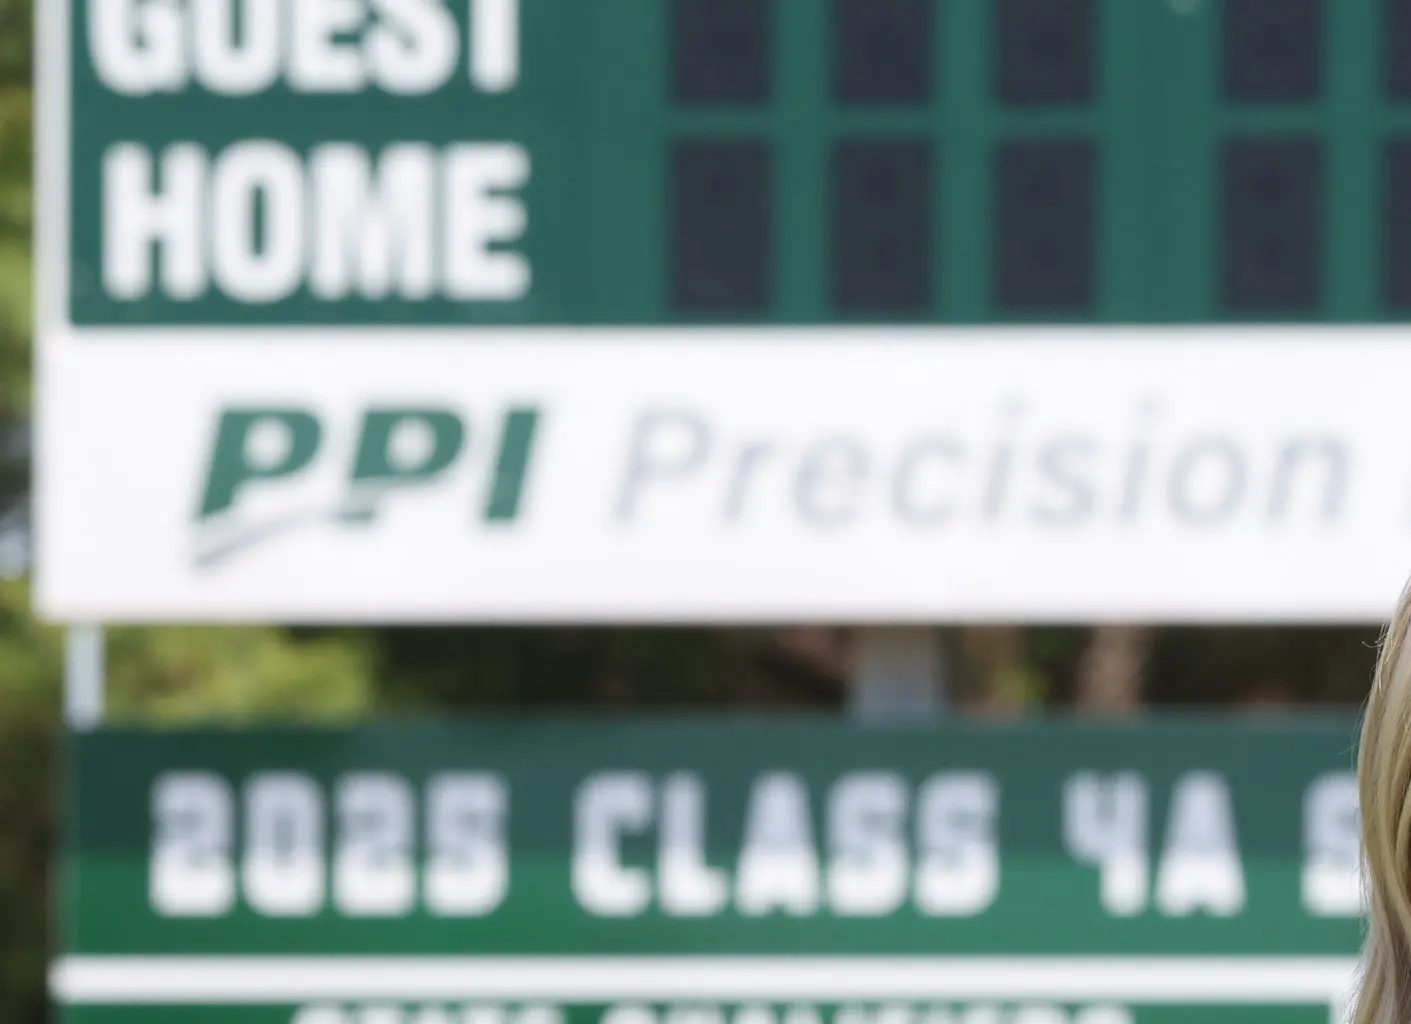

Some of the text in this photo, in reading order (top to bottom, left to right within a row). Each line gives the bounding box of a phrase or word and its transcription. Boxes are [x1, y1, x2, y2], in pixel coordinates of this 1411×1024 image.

[102, 140, 530, 303] HOME
[193, 403, 543, 526] PPI
[610, 400, 1353, 530] Precision
[149, 775, 509, 918] 2025
[571, 774, 1000, 918] CLASS
[1064, 774, 1247, 918] 4A
